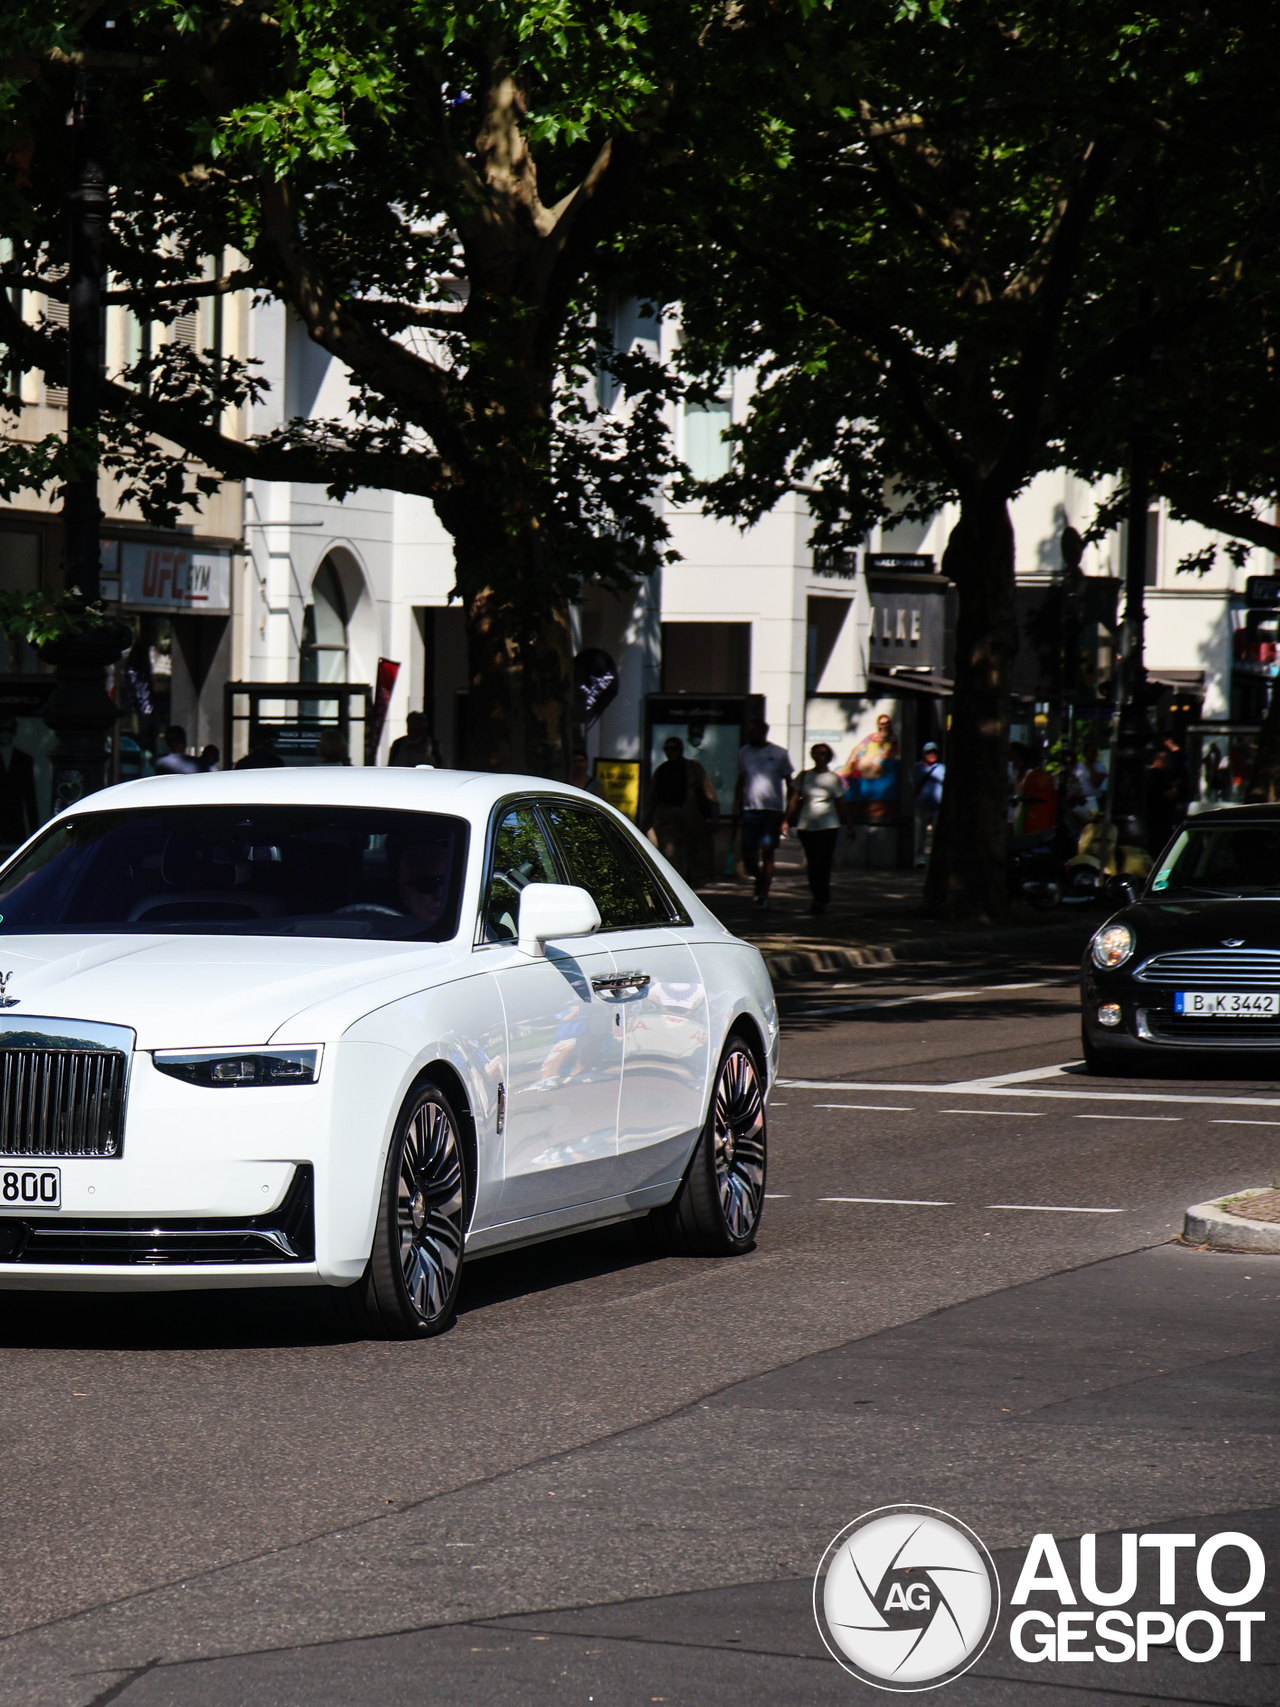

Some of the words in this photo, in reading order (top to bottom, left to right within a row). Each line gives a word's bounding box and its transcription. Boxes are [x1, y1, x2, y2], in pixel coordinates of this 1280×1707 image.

[142, 549, 187, 598] UFC
[186, 565, 211, 591] GYM
[1194, 995, 1204, 1011] B
[1216, 995, 1226, 1011] K
[1231, 996, 1273, 1012] 3442
[2, 1172, 57, 1202] 800
